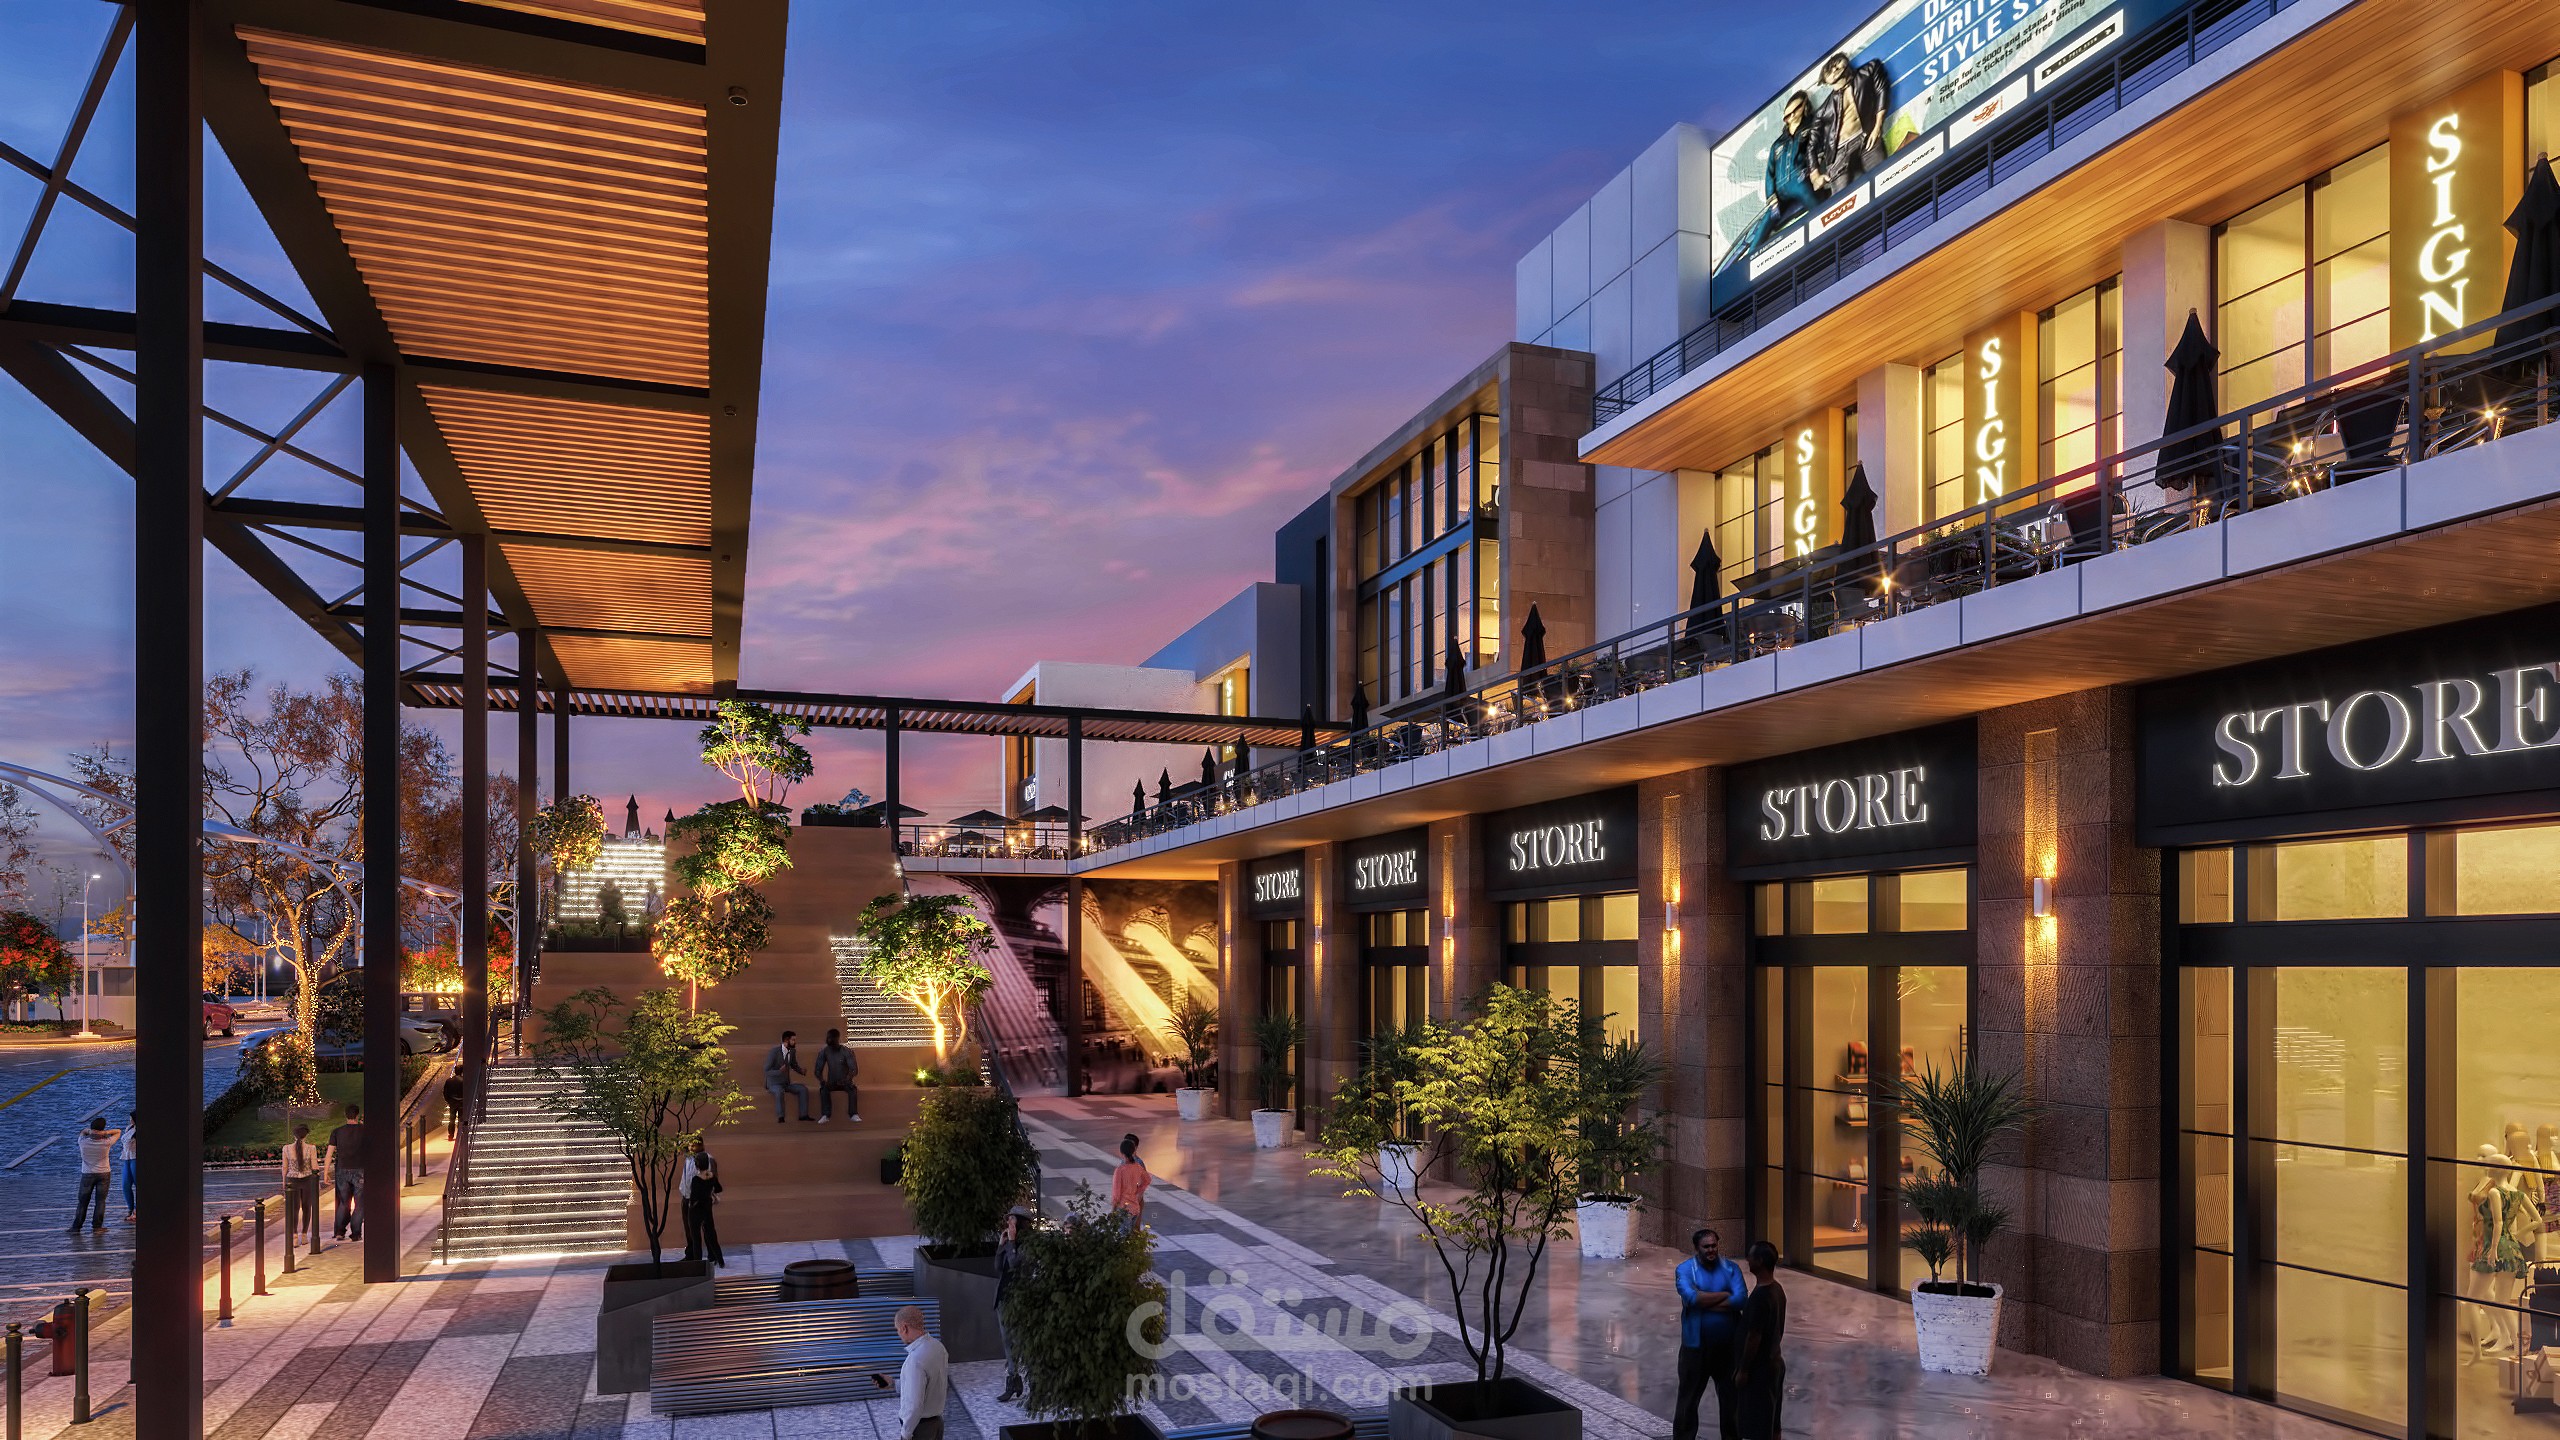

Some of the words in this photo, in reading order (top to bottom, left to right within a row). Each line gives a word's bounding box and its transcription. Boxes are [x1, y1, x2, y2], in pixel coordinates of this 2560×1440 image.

[1923, 0, 2002, 54] WRIT
[1924, 10, 2002, 85] STYLE
[1939, 77, 1959, 95] Shop
[1961, 67, 1974, 80] for
[2004, 32, 2021, 49] and
[2023, 13, 2048, 36] stand
[2051, 8, 2057, 16] a
[1939, 89, 1955, 103] free
[1957, 70, 1982, 91] movie
[1984, 48, 2014, 72] tickets
[2016, 34, 2033, 50] and
[2035, 20, 2053, 36] free
[2056, 0, 2086, 21] dining
[2419, 113, 2471, 343] SIGN
[1976, 337, 2006, 505] SIGN
[2212, 661, 2560, 786] STORE
[1760, 765, 1929, 842] STORE
[1354, 849, 1418, 891] STORE
[1508, 819, 1606, 872] STORE
[1254, 869, 1300, 903] STORE
